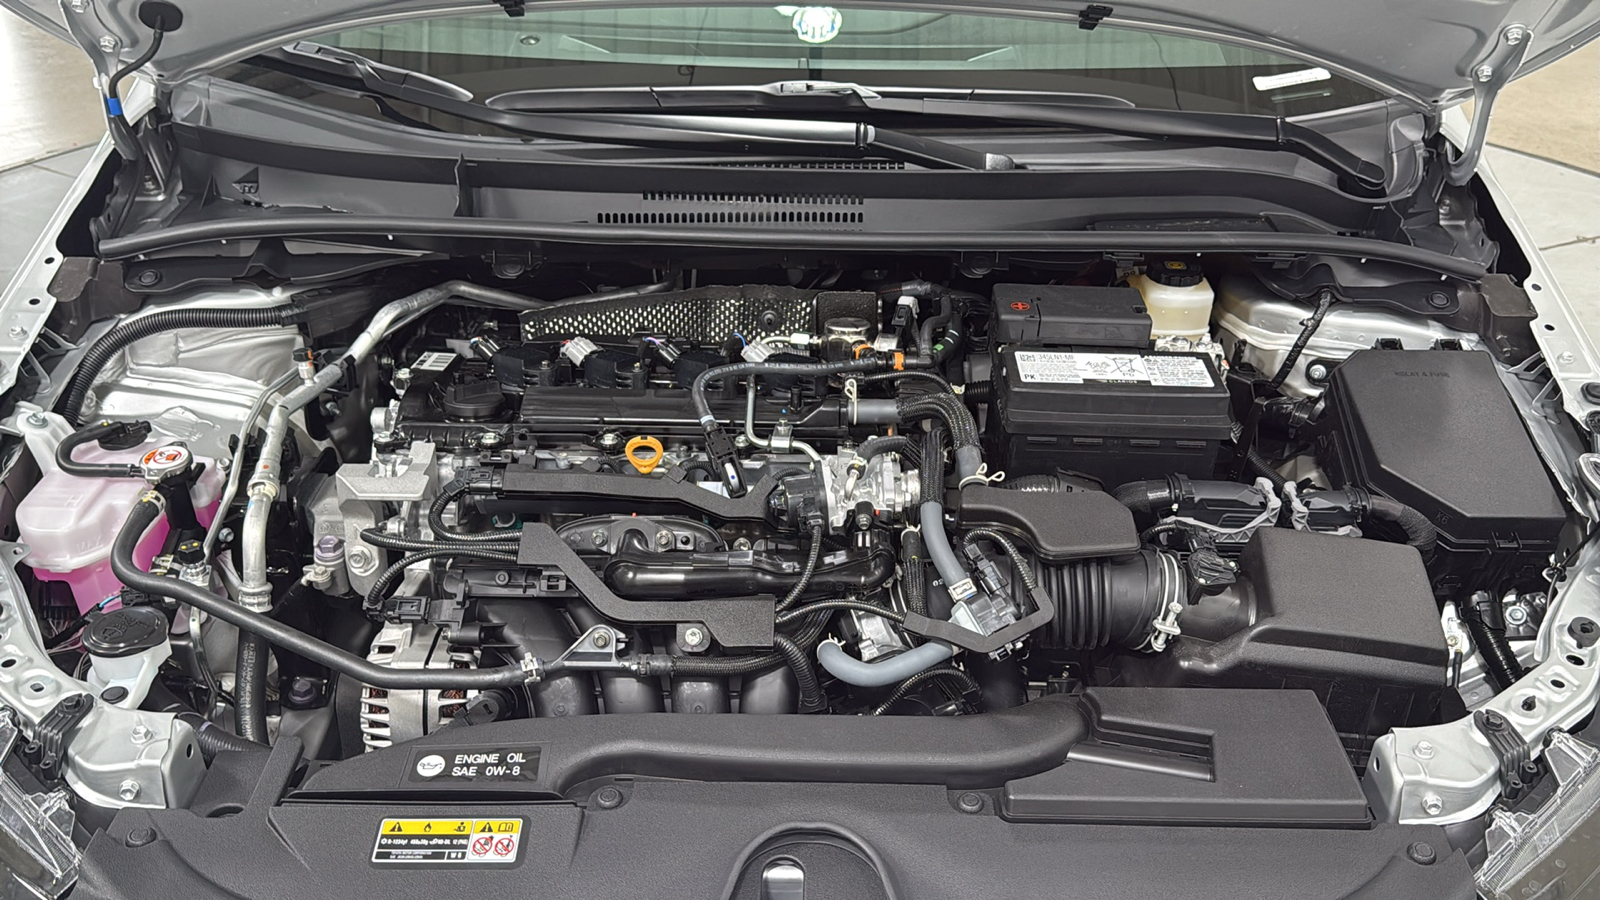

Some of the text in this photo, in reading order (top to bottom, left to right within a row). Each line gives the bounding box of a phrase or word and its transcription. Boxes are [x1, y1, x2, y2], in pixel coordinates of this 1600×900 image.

[454, 752, 526, 764] ENGINE OIL
[451, 765, 521, 776] SAE 0W-8
